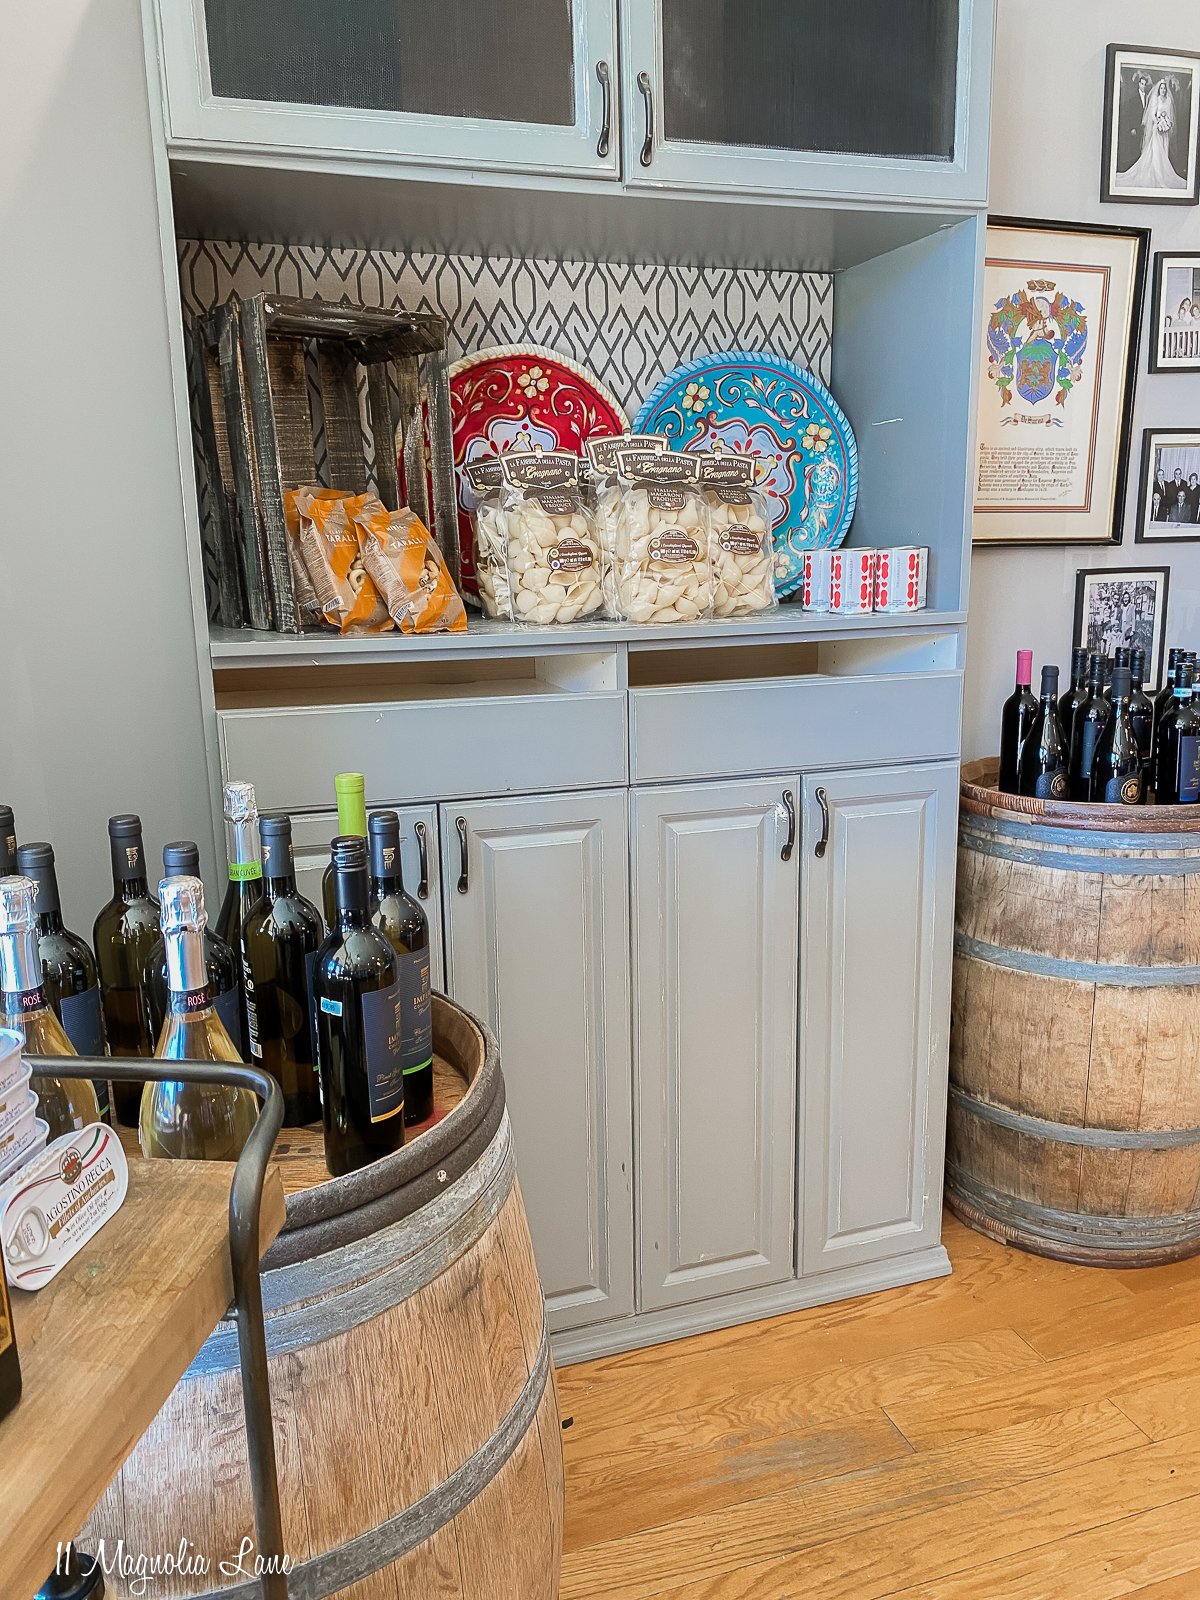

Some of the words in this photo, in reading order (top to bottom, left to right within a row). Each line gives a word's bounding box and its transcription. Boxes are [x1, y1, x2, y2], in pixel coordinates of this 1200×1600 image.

[555, 458, 572, 467] PASTA
[675, 456, 694, 466] PASTA
[733, 460, 749, 470] PASTA
[325, 534, 357, 542] TARALL
[390, 537, 425, 549] TARALLI
[46, 1181, 86, 1222] AGOSTINO
[85, 1157, 112, 1186] RECCA
[58, 1211, 75, 1228] Fillets
[81, 1180, 107, 1205] Anchovies
